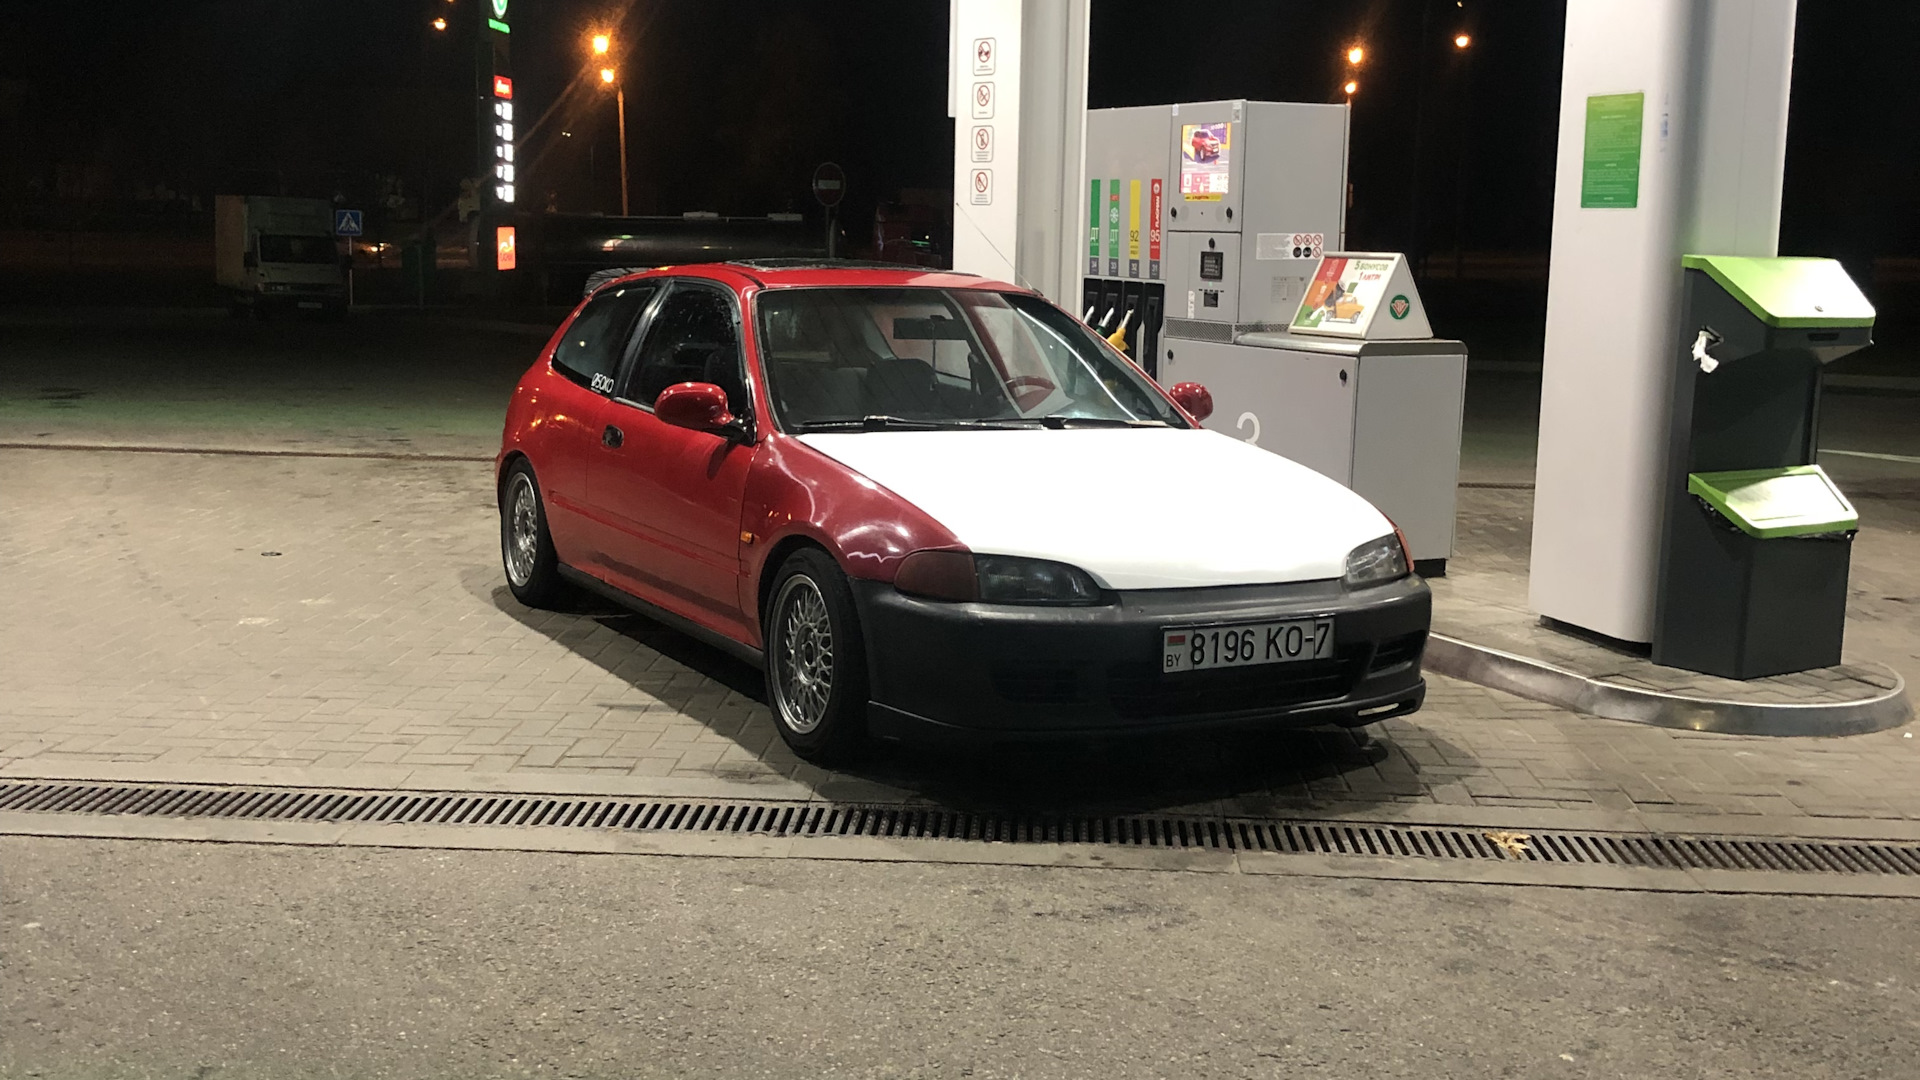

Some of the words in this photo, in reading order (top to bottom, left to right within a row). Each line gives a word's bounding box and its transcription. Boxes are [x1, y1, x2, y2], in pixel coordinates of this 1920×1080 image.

[1130, 230, 1139, 242] 92
[1150, 229, 1160, 242] 95
[1354, 260, 1361, 270] 5
[1360, 262, 1388, 271] БОНУСОВ
[1359, 271, 1363, 281] 1
[1190, 629, 1255, 665] 8196
[1266, 623, 1330, 660] KO-7
[1166, 654, 1181, 668] BY
